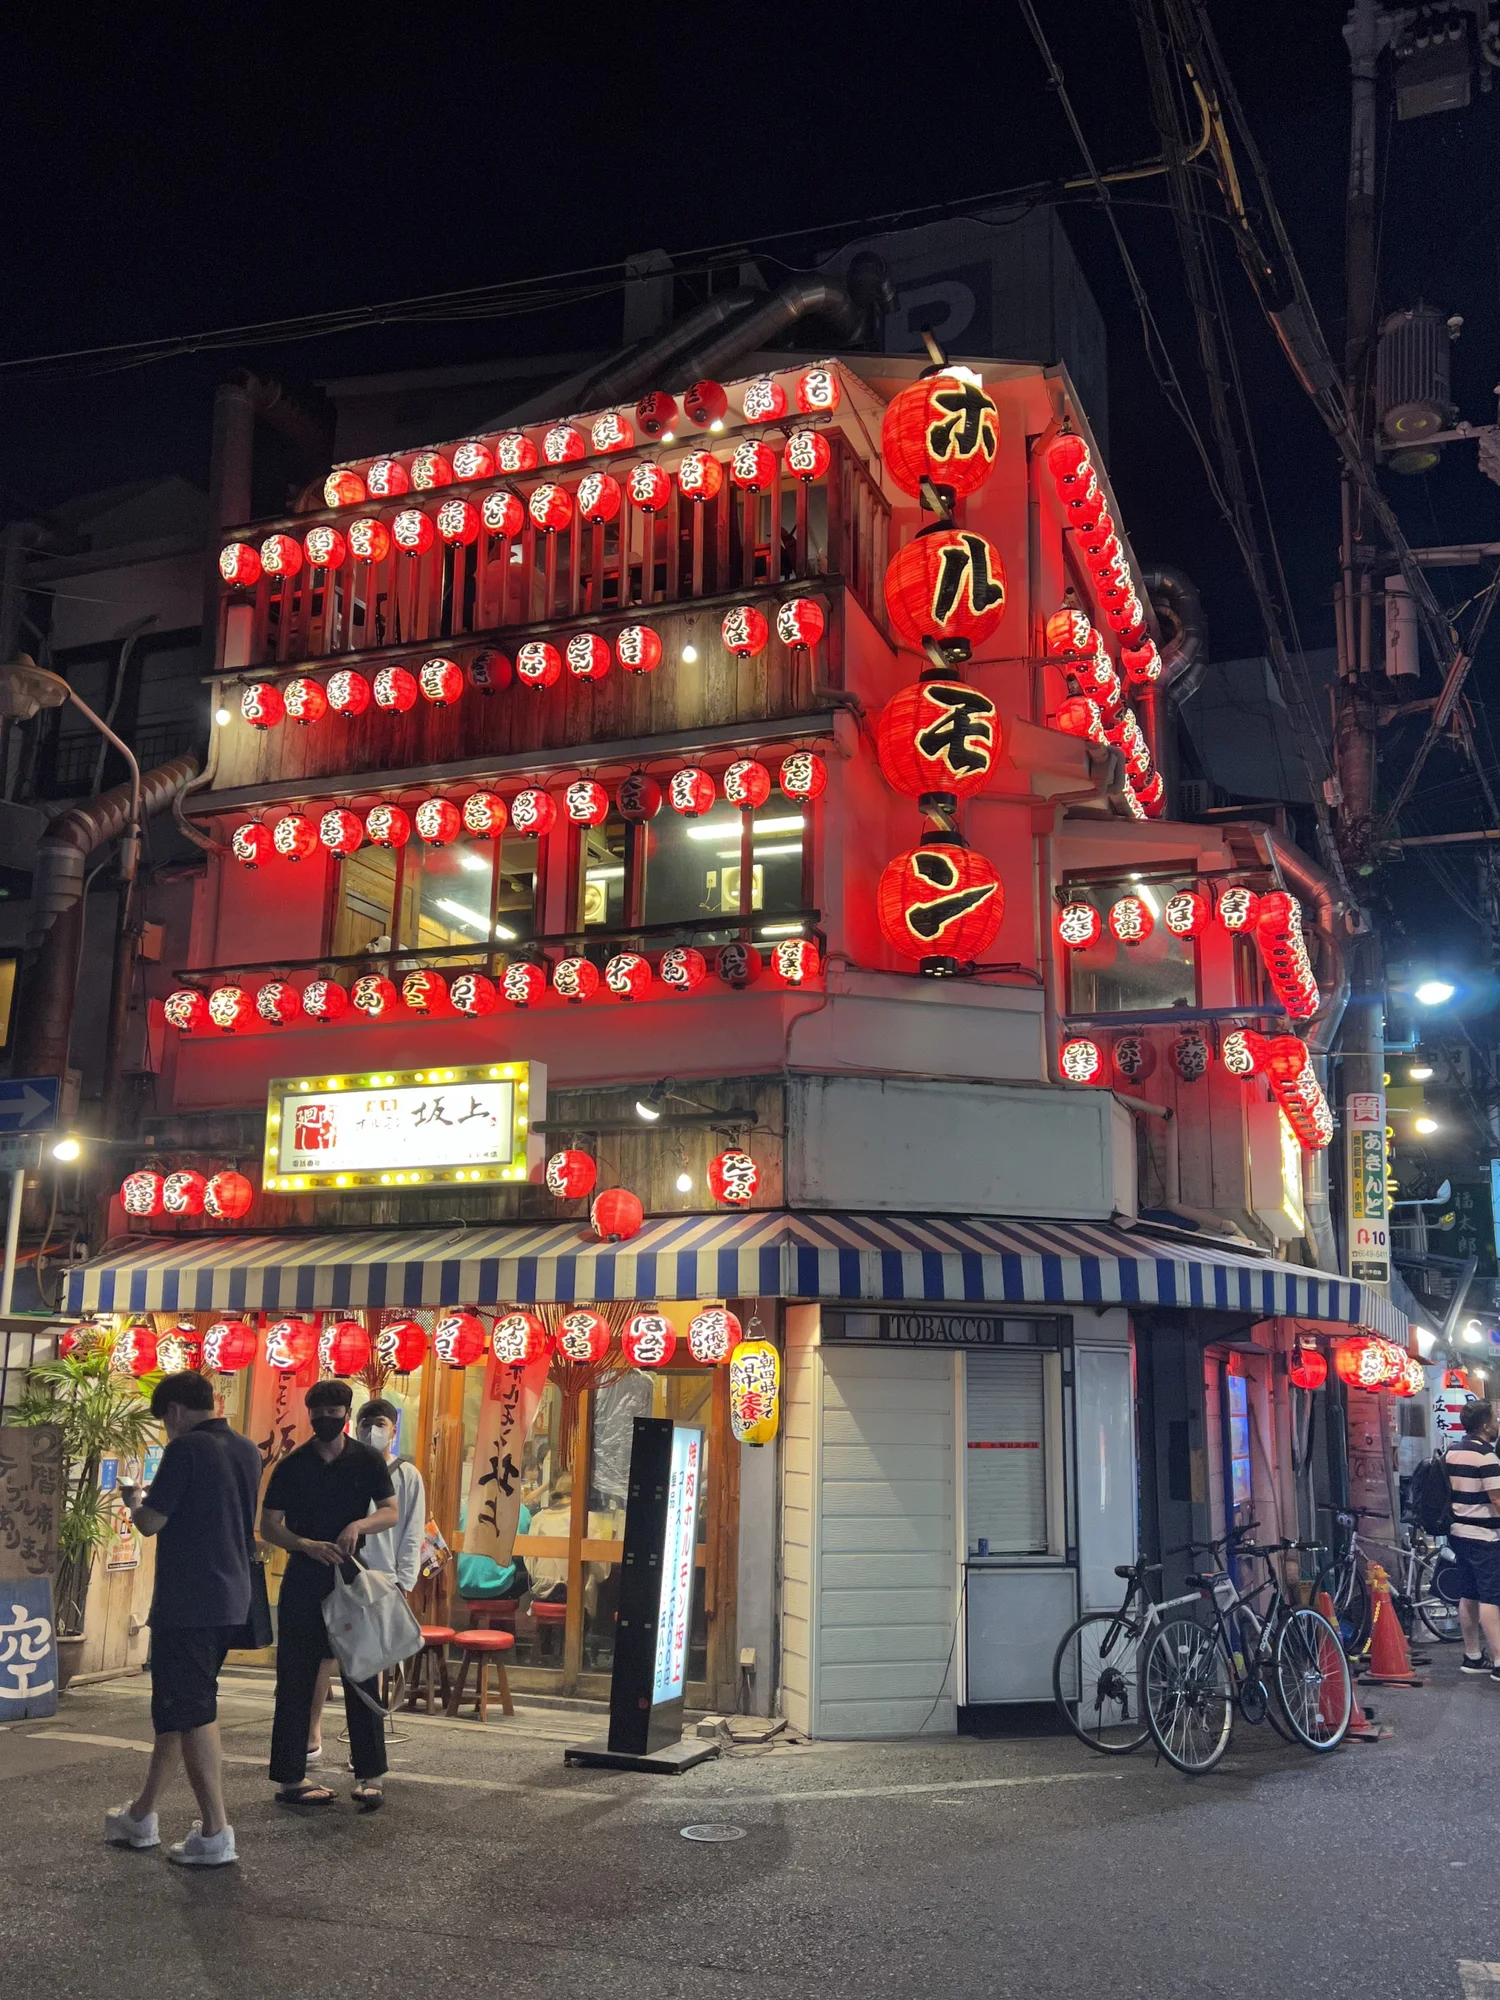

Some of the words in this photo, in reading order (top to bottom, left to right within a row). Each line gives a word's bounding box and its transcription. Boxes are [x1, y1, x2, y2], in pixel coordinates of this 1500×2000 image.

[809, 371, 828, 402] うち
[519, 642, 544, 676] ほな
[421, 658, 445, 698] めばちこ
[569, 782, 596, 818] まいど
[621, 776, 646, 813] 大阪
[1066, 905, 1092, 938] ホルモン
[1167, 895, 1192, 931] あほか
[606, 954, 637, 992] ボイン
[720, 943, 747, 979] へたれ
[779, 941, 803, 977] ほなまた
[402, 971, 428, 1006] ミナミ
[411, 1096, 490, 1127] 坂上
[1354, 1096, 1379, 1121] 質
[164, 1173, 192, 1212] ぱちもん
[724, 1154, 755, 1199] なんでっか
[1364, 1132, 1382, 1216] あきんど
[1372, 1231, 1386, 1246] 10
[1455, 1191, 1477, 1254] 福太郎
[266, 1324, 294, 1367] 芸人
[437, 1318, 460, 1363] ツッコミ
[564, 1313, 595, 1358] 焼きまっせ
[633, 1317, 663, 1361] はみご
[892, 1316, 992, 1342] TOBACCO
[739, 1356, 763, 1430] 一日中定食が
[758, 1350, 778, 1419] 朝四時まで
[0, 1604, 55, 1699] 空
